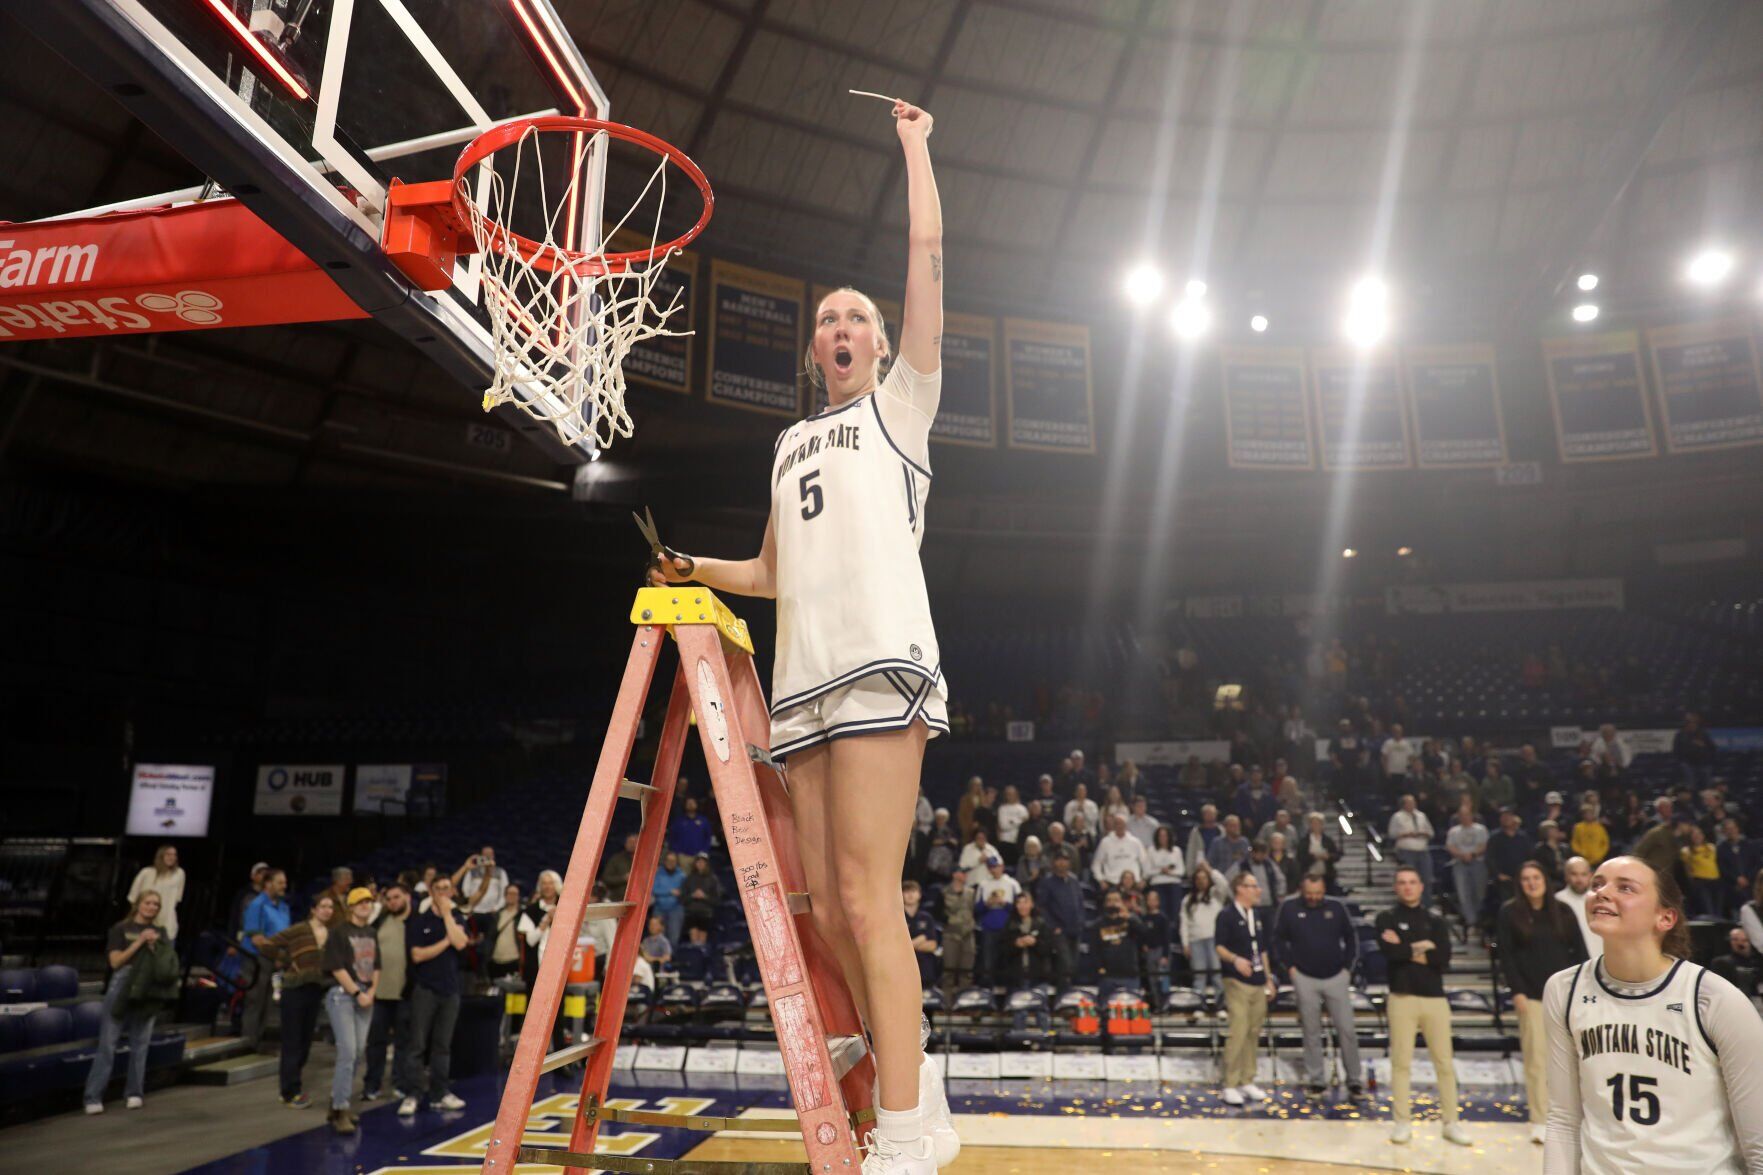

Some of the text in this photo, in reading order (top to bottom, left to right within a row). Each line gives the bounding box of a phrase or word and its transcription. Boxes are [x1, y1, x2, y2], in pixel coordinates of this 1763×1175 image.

[722, 299, 793, 325] BASKETBALL
[713, 382, 796, 409] CHAMPIONS
[714, 371, 796, 394] CONFERENCE
[799, 469, 824, 521] 5
[292, 770, 333, 788] HUB
[1580, 1023, 1692, 1076] MONTANA STATE
[1606, 1072, 1661, 1126] 15
